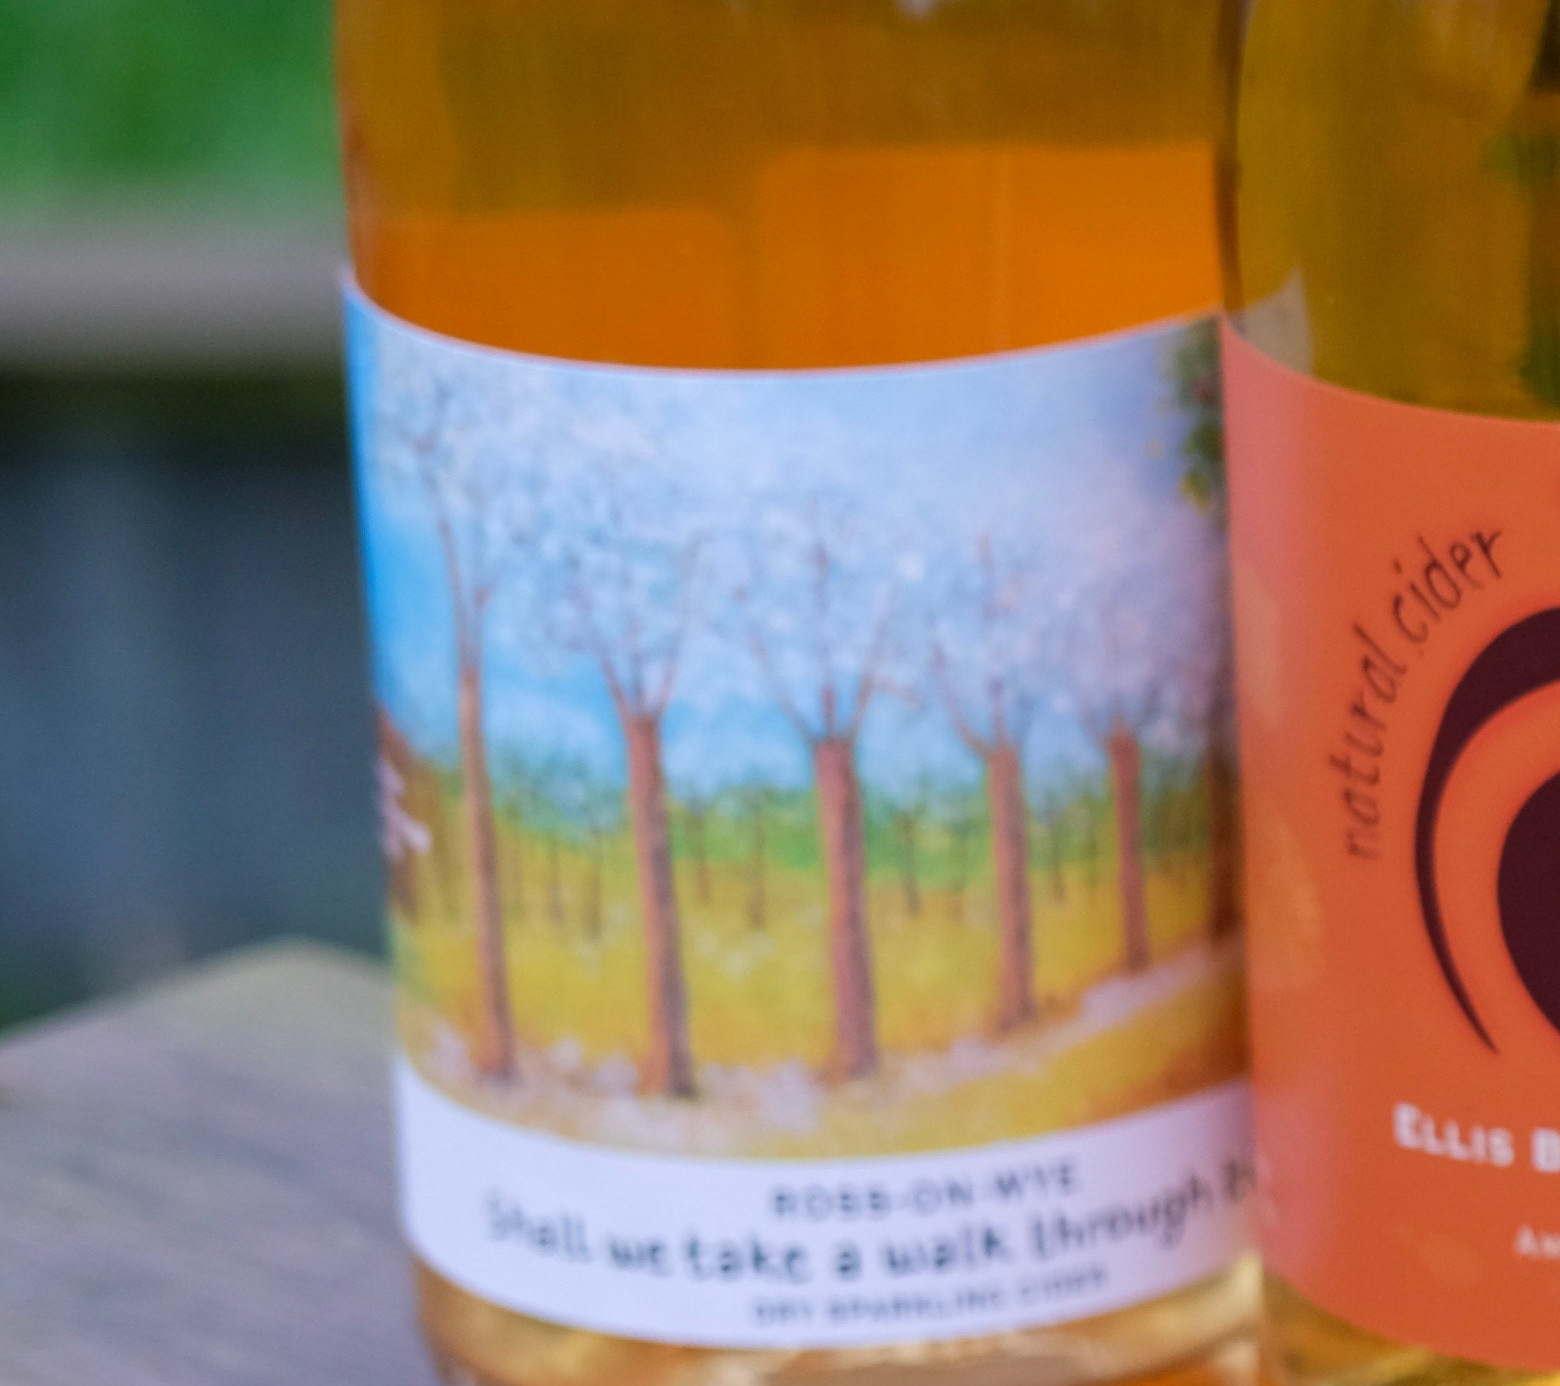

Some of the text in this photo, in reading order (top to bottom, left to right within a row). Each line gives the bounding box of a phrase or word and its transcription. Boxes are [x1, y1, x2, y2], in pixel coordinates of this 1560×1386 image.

[1330, 530, 1502, 860] natural cider
[1394, 1102, 1514, 1168] ELLIS
[687, 1233, 810, 1282] take
[837, 1240, 862, 1281] a
[884, 1225, 1009, 1275] walk
